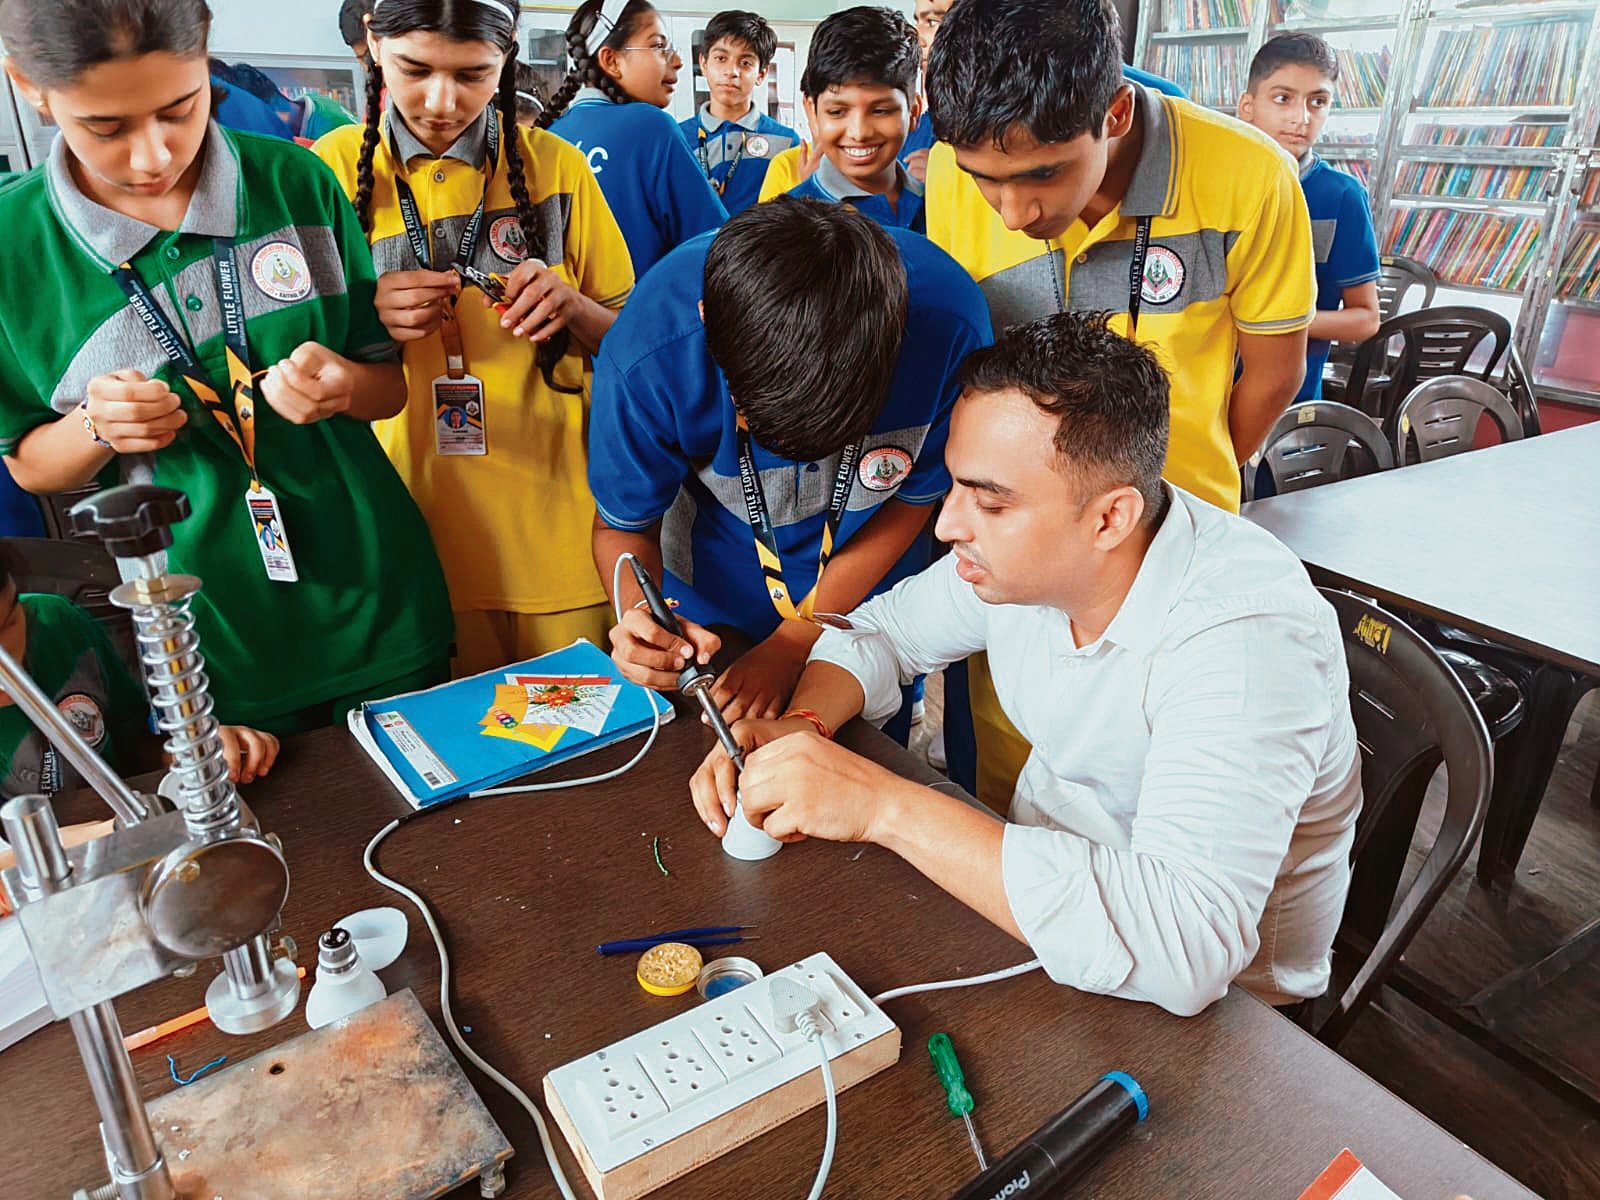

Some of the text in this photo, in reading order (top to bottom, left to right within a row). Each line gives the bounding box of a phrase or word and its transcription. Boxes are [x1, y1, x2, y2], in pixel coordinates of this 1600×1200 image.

[401, 199, 414, 229] FLOWER
[409, 231, 422, 256] LITTLE
[459, 231, 472, 256] LITTLE
[1131, 225, 1145, 294] LITTLE FLOWER
[219, 260, 239, 334] LITTLE FLOWER
[129, 293, 181, 360] LITTLE FLOWER
[738, 456, 760, 523] LITTLE FLOWER
[830, 481, 845, 511] LITTLE
[838, 444, 855, 480] FLOWER
[41, 751, 52, 790] FLOWER
[989, 1170, 1030, 1200] Pion
